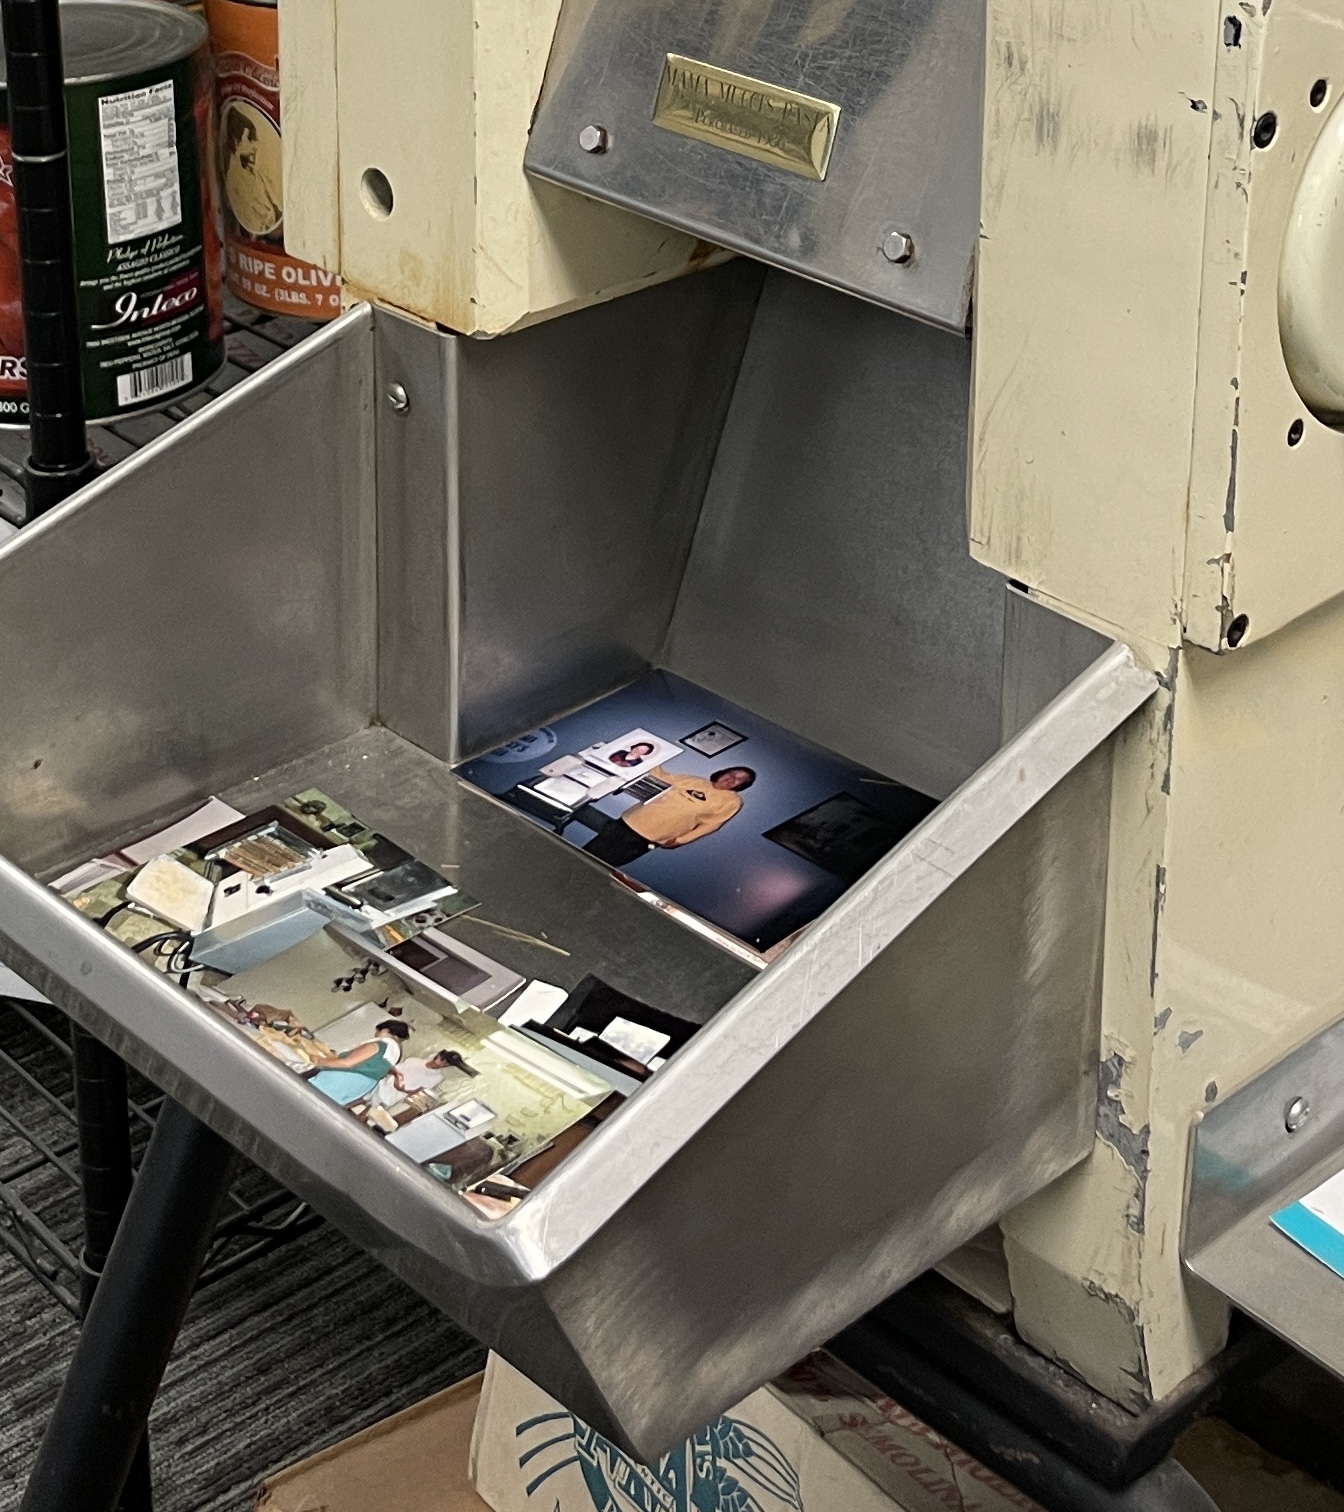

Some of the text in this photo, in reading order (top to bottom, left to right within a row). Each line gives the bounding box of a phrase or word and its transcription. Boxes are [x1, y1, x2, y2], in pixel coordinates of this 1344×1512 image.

[101, 90, 147, 106] Nutrition
[667, 65, 831, 136] MAMA MUCCI'S PASTA
[239, 253, 276, 280] RIPE
[316, 294, 323, 306] 7
[329, 294, 340, 306] O
